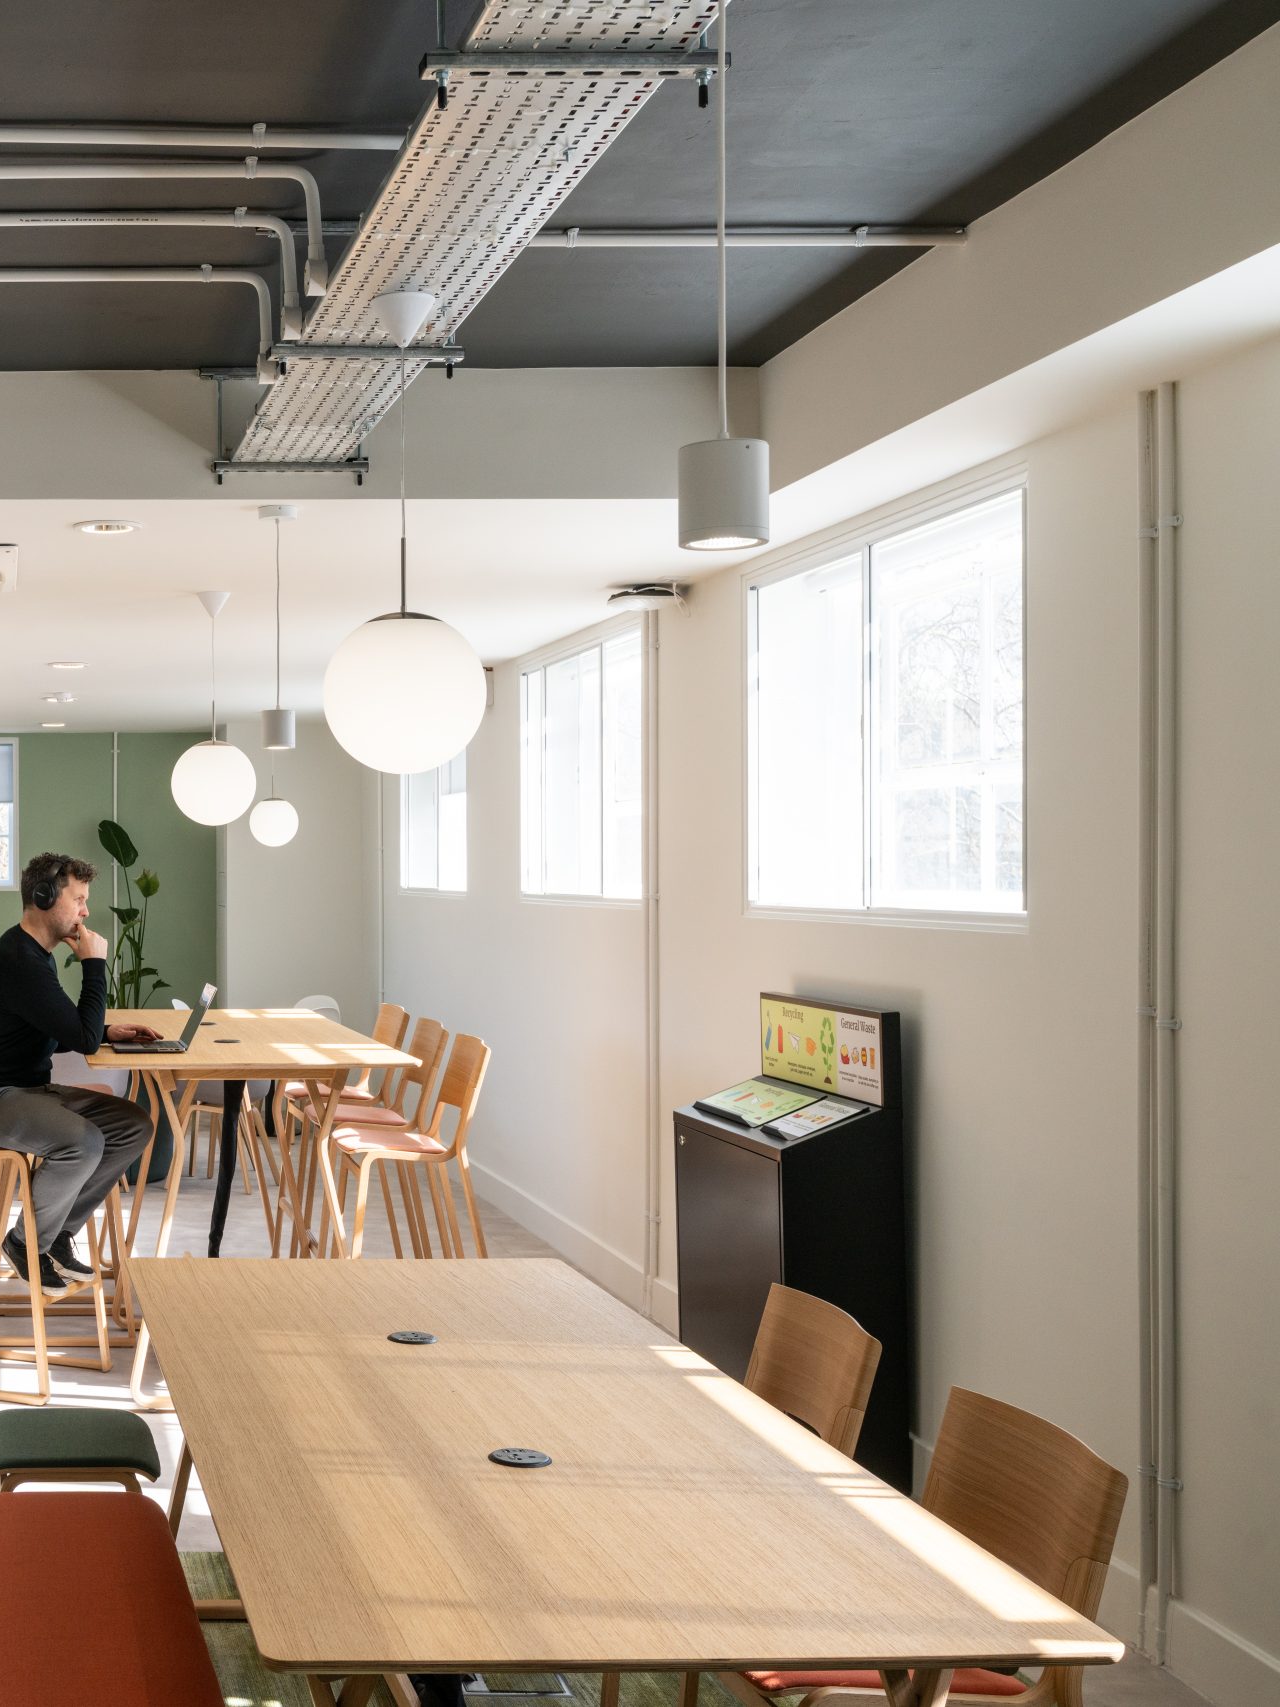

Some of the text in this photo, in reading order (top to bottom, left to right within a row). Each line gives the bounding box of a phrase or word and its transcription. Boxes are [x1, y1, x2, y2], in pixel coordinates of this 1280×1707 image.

[782, 1006, 804, 1023] Recycling
[841, 1017, 876, 1034] General Waste
